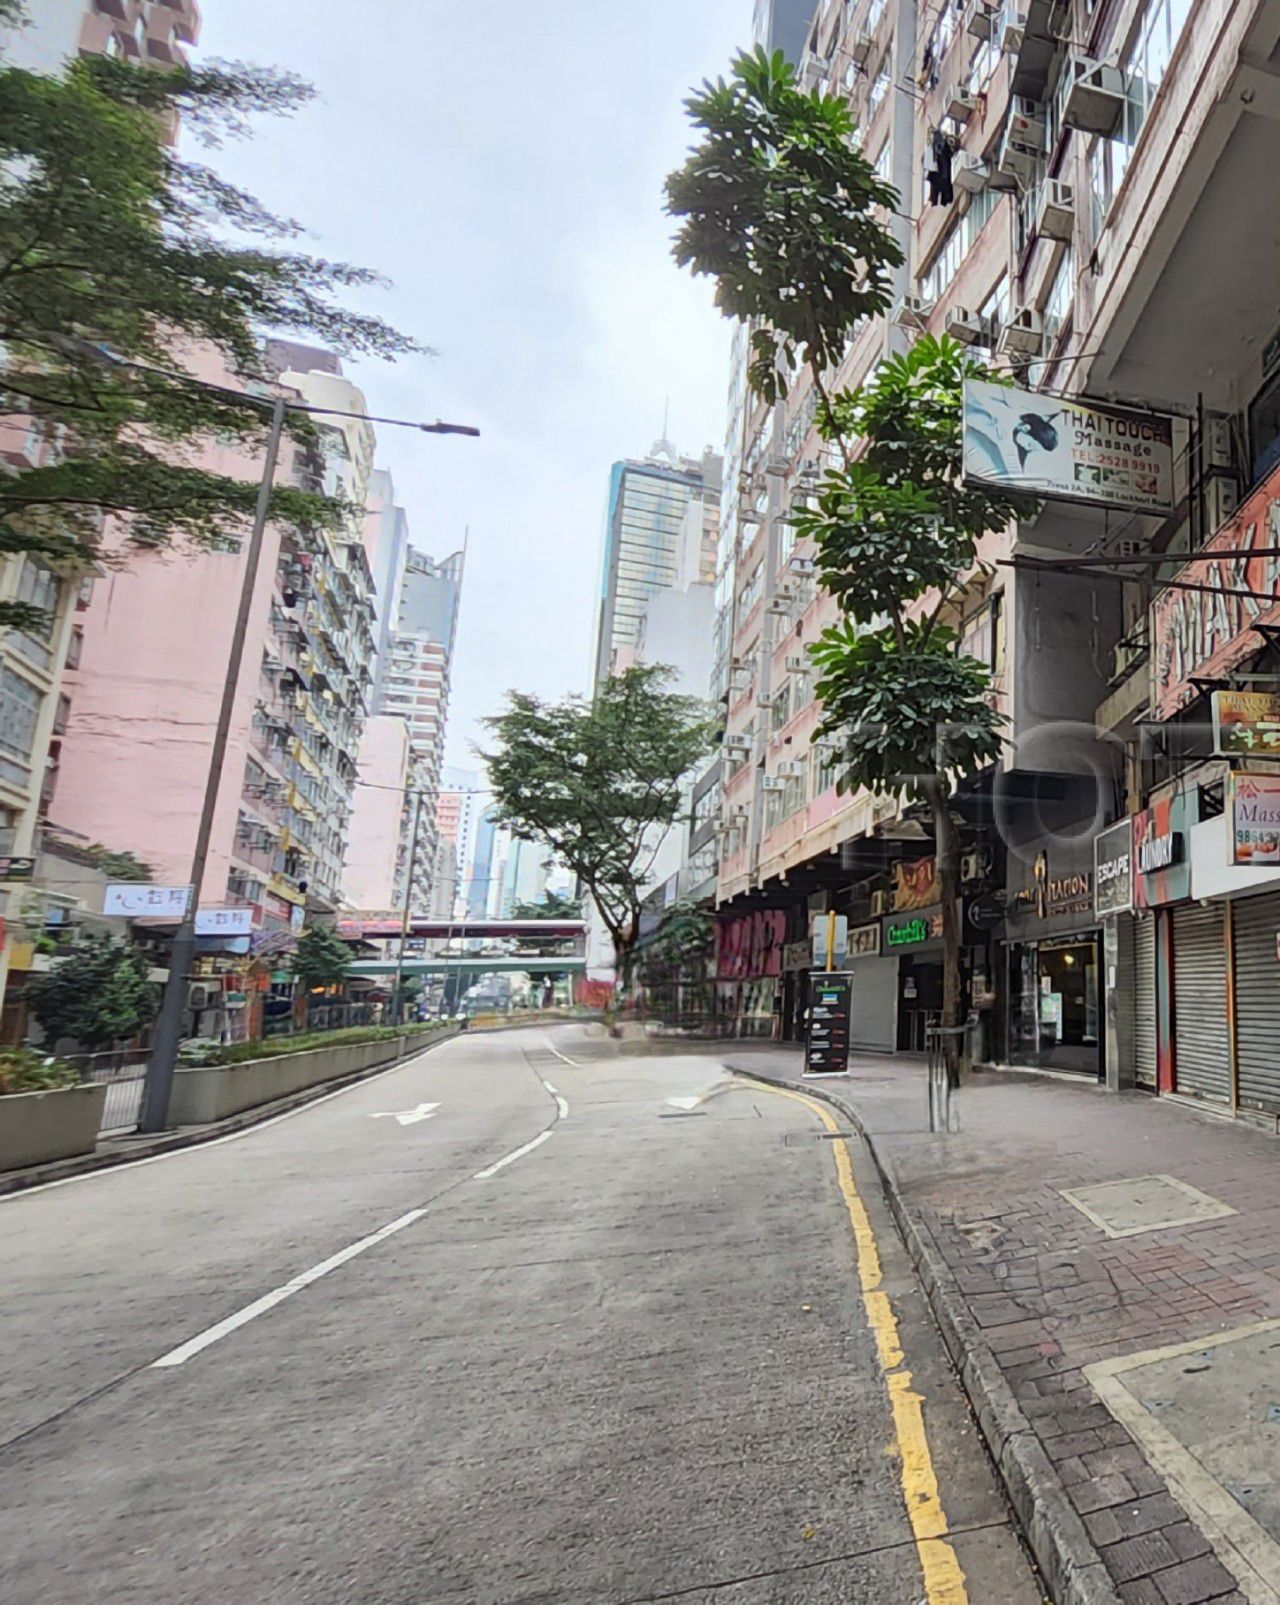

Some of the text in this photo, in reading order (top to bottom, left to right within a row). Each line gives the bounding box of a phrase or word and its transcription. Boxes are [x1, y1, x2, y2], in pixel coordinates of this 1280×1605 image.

[1060, 408, 1164, 443] THAI TOUCH
[1074, 431, 1152, 457] Massage
[1097, 853, 1130, 885] ESCAPE
